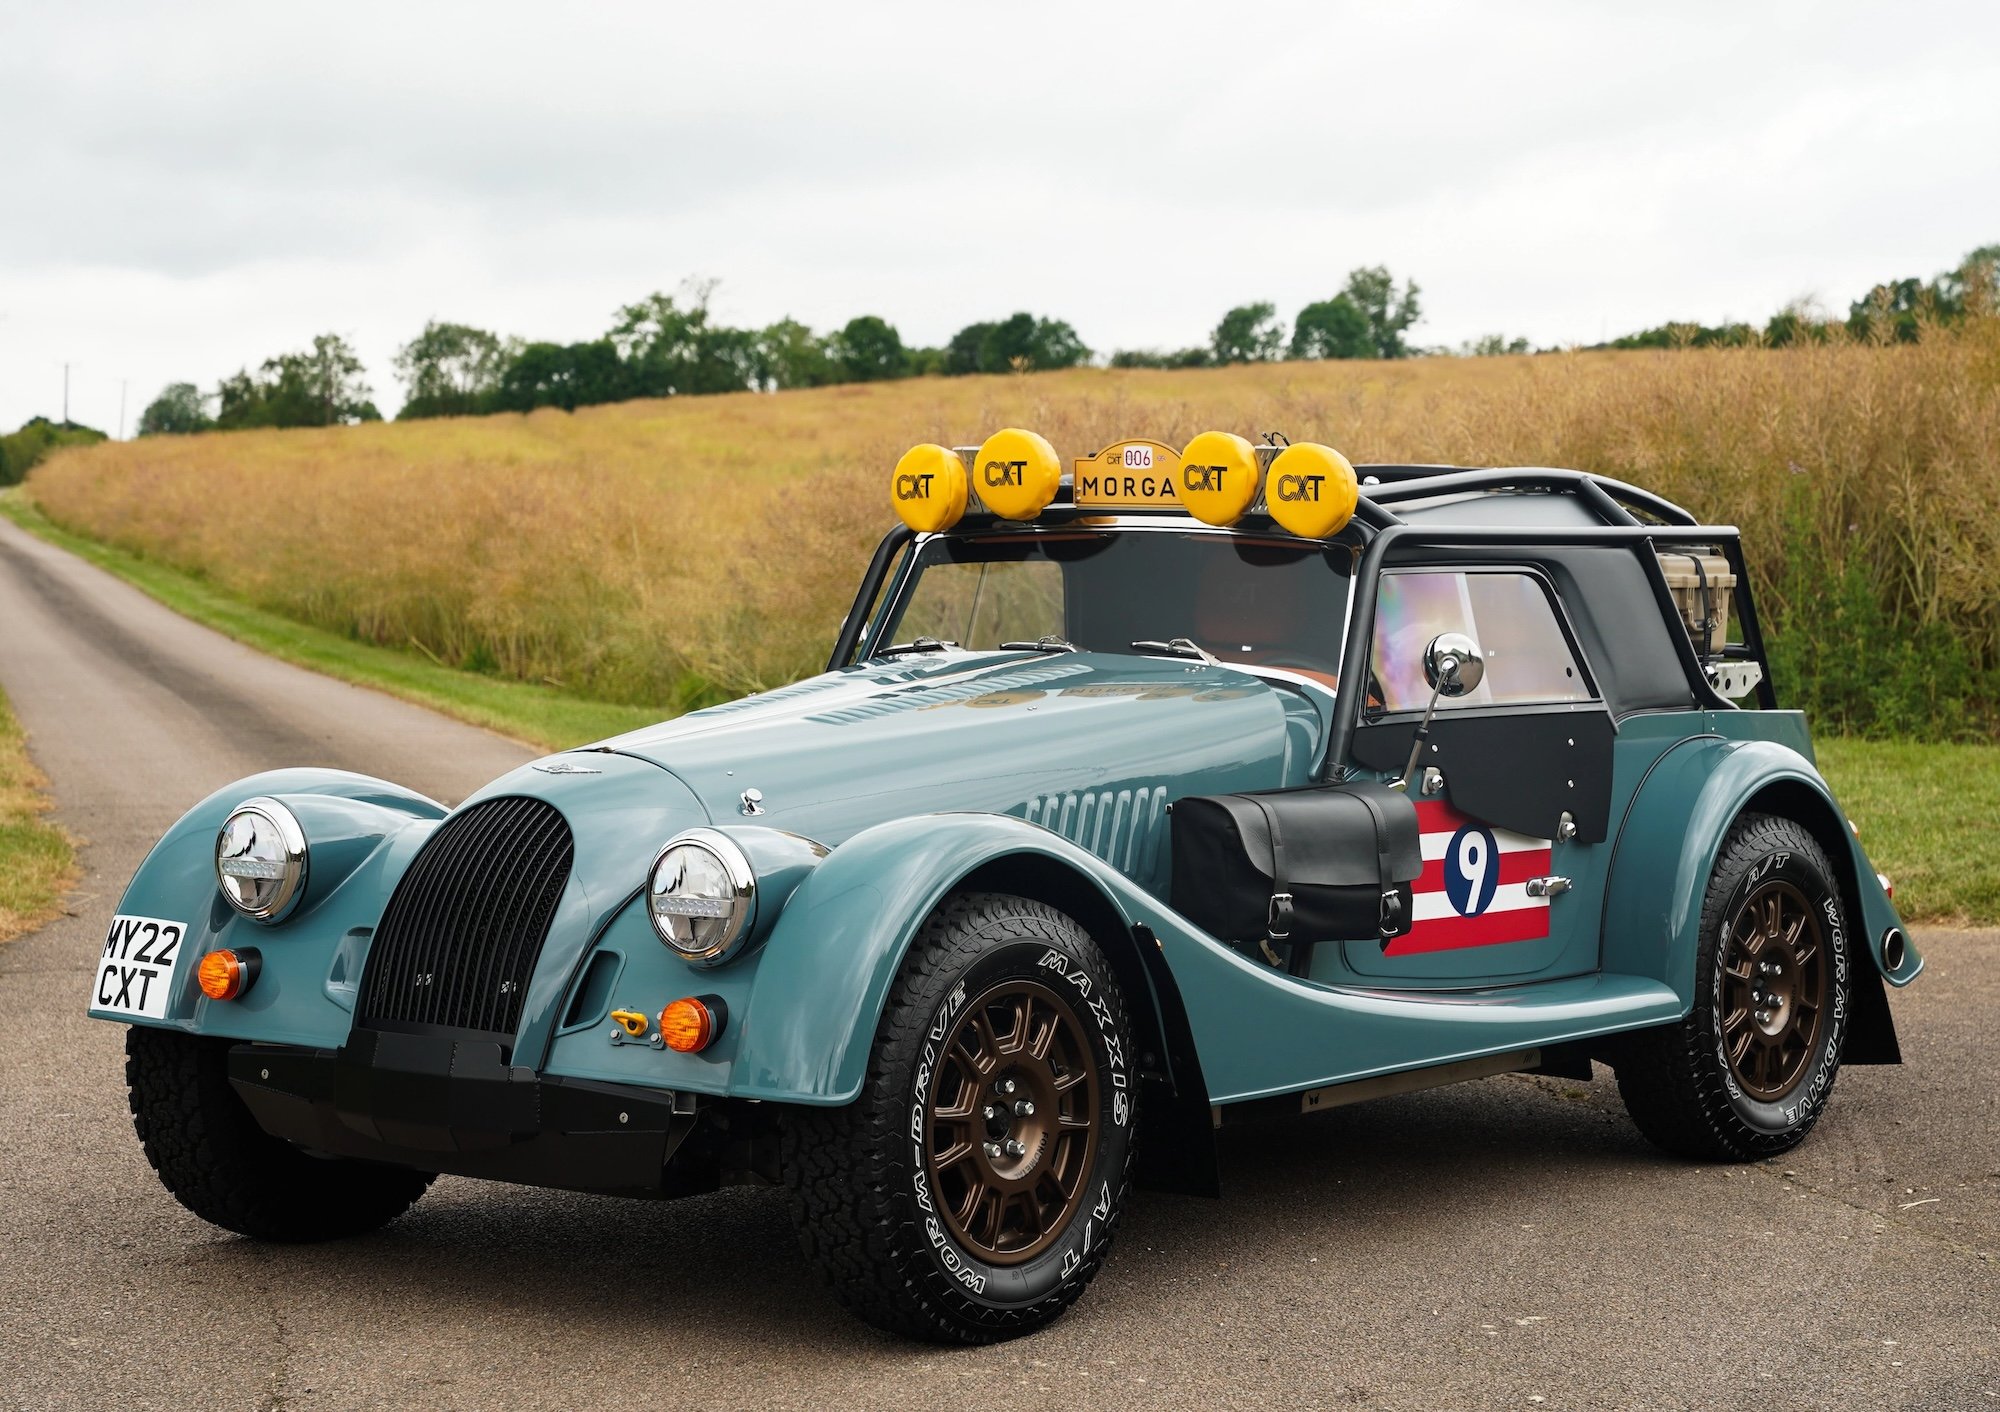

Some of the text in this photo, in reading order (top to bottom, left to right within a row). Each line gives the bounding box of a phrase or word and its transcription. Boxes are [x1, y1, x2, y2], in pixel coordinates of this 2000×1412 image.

[1083, 477, 1176, 497] MORGA
[1125, 450, 1151, 466] 006
[1458, 830, 1488, 914] 9
[1745, 852, 1790, 894] A/T
[103, 919, 180, 966] MY22
[99, 965, 158, 1011] CXT
[1786, 897, 1846, 1125] WORM-DRIVE
[1038, 948, 1128, 1128] MAXXIS
[911, 980, 986, 1294] WORM-DRIVE
[1060, 1181, 1112, 1280] A/T
